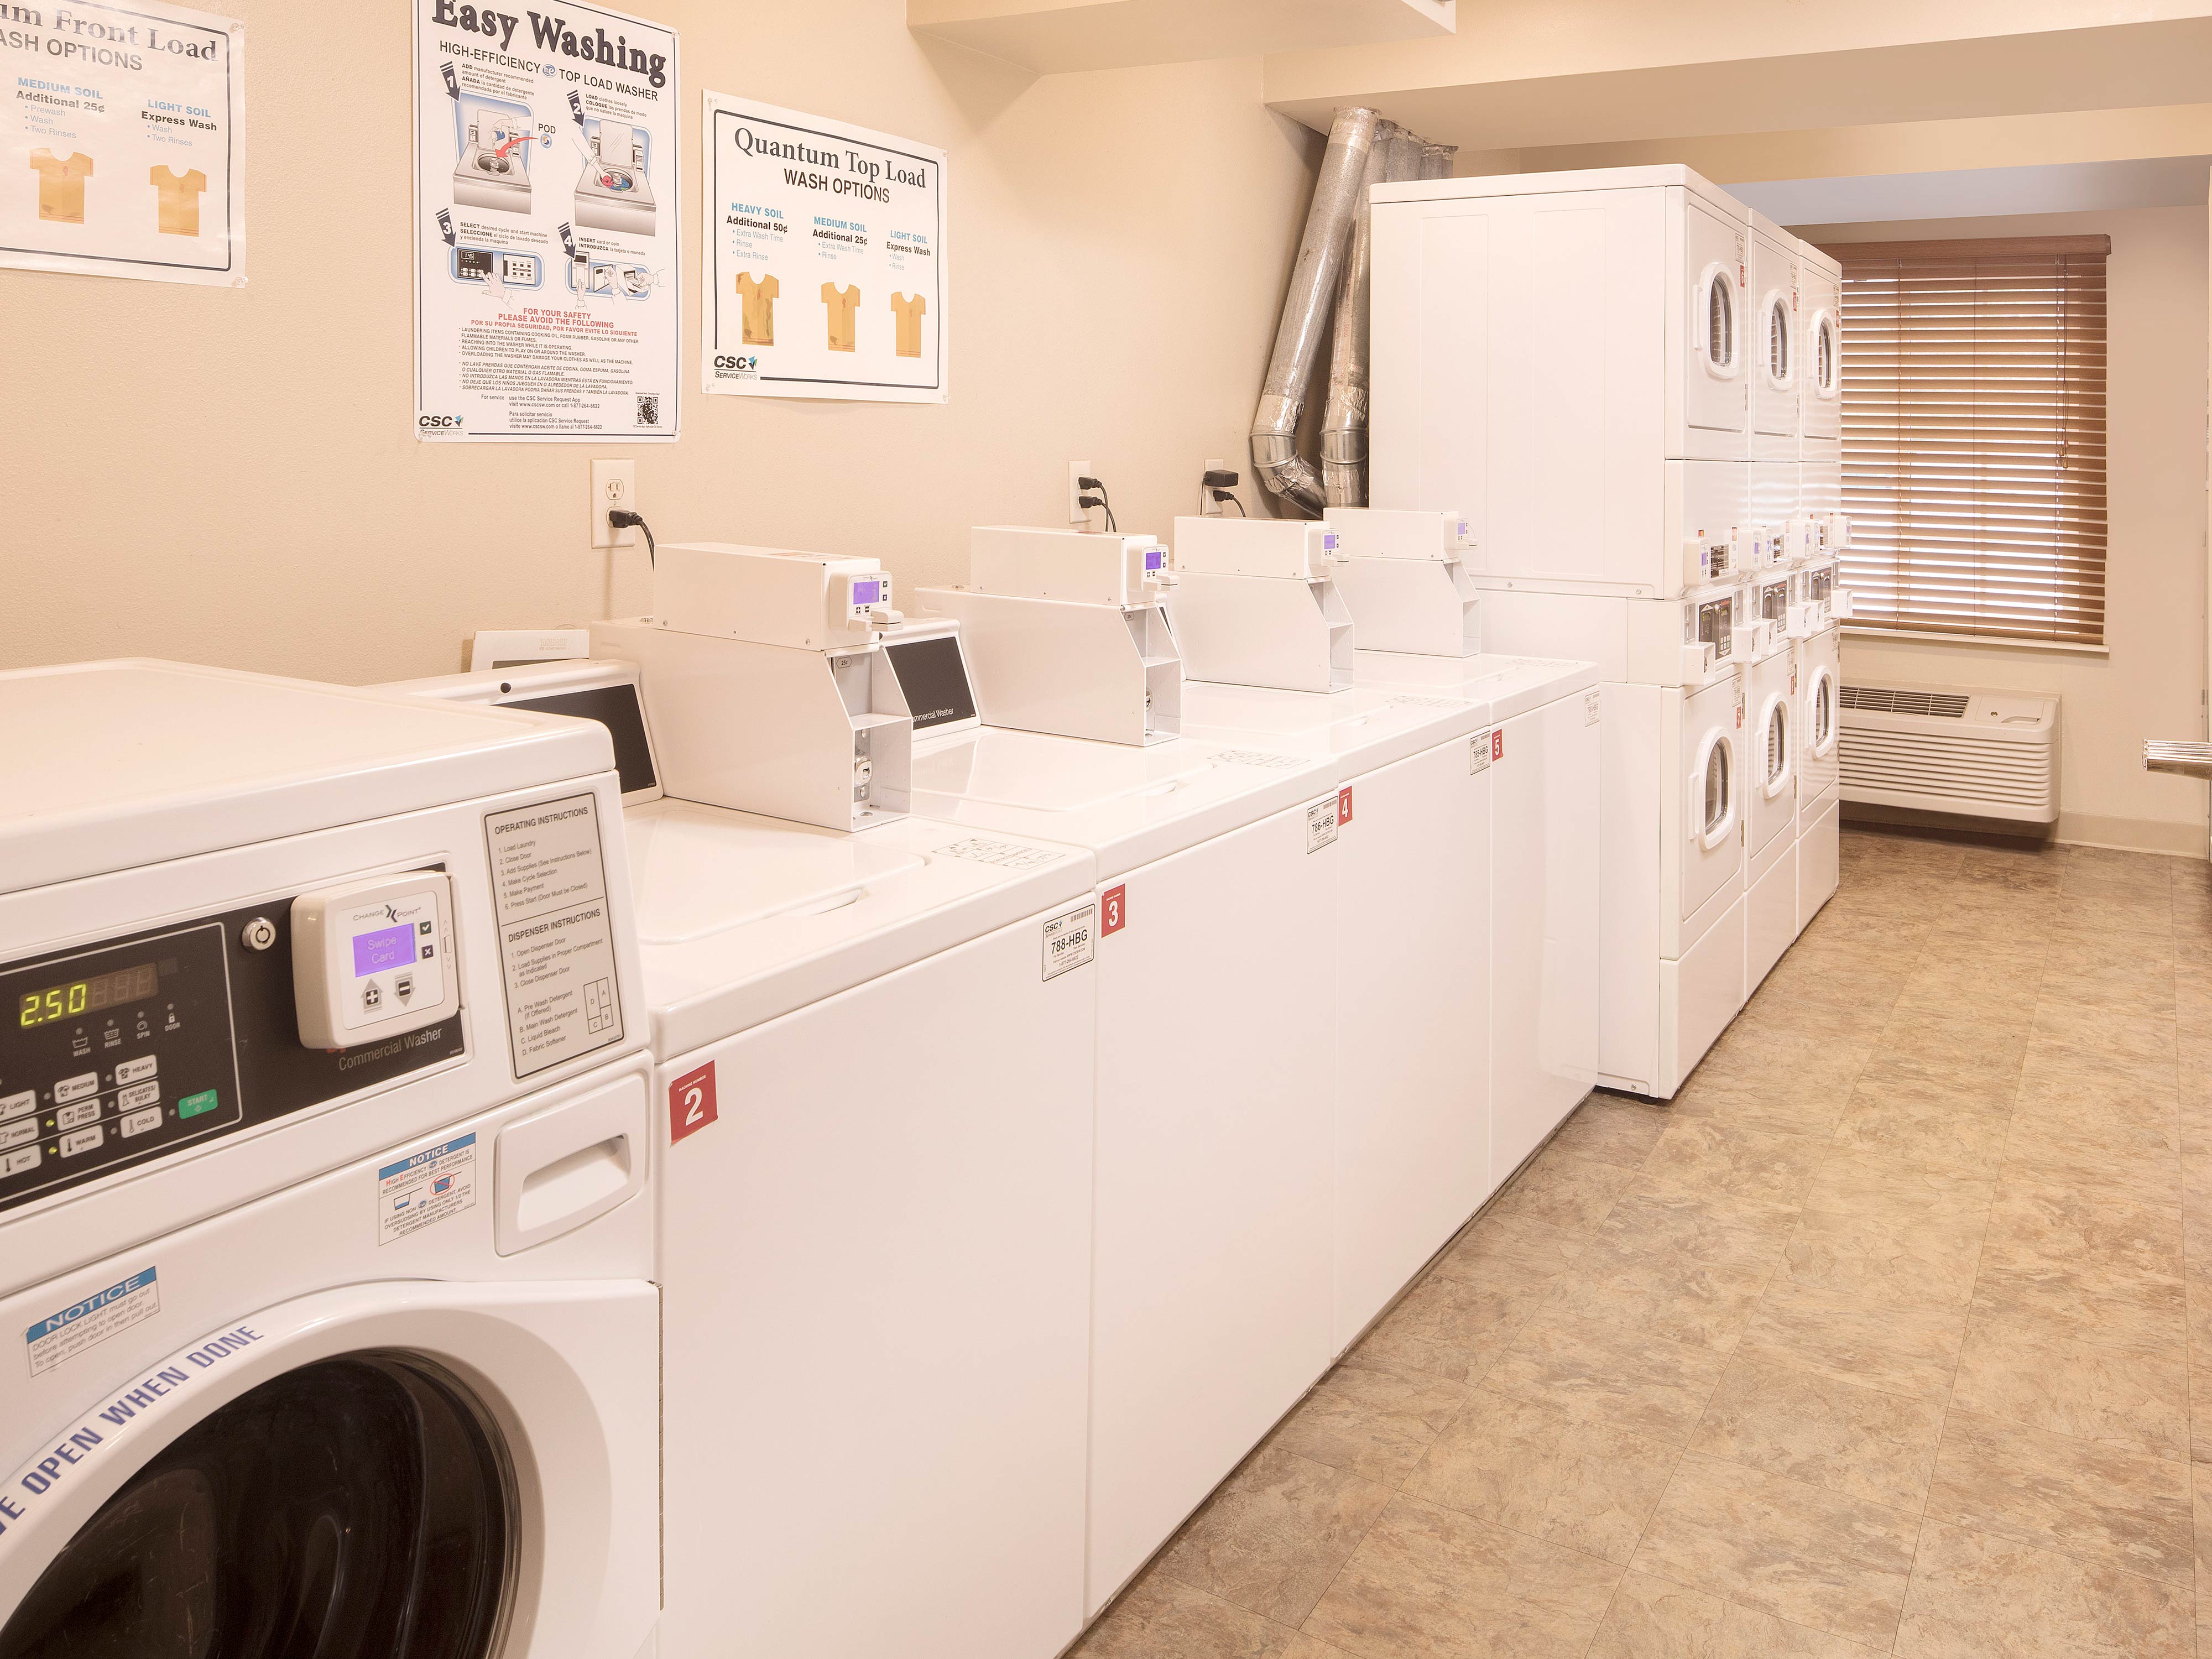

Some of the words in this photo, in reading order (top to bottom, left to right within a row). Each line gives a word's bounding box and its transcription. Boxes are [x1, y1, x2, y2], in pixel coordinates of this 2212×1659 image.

[54, 9, 139, 45] Front
[148, 28, 218, 61] Load
[432, 0, 518, 51] Easy
[527, 11, 666, 88] Washing
[47, 39, 142, 71] OPTIONS
[440, 40, 541, 73] HIGH-EFFICIENCY
[559, 69, 580, 82] TOP
[584, 75, 612, 90] LOAD
[615, 82, 658, 101] WASHER
[474, 67, 503, 76] manufacturer
[504, 74, 534, 83] recommended
[447, 75, 453, 88] 1
[18, 77, 70, 94] MEDIUM
[75, 87, 103, 100] SOIL
[16, 91, 79, 108] Additional
[84, 102, 105, 113] 25¢
[573, 103, 581, 114] 2
[30, 105, 66, 116] Prewash
[148, 100, 182, 112] LIGHT
[186, 106, 211, 118] SOIL
[30, 115, 53, 124] Wash
[142, 111, 185, 126] Express
[189, 119, 217, 131] Wash
[30, 125, 46, 134] Two
[49, 128, 76, 138] Rinses
[152, 124, 172, 133] Wash
[539, 123, 556, 134] POD
[168, 137, 192, 146] Rinses
[734, 128, 840, 169] Quantum
[846, 150, 880, 184] Top
[885, 159, 926, 188] Load
[784, 168, 828, 192] WASH
[833, 178, 890, 204] OPTIONS
[732, 202, 761, 215] HEAVY
[765, 208, 784, 219] SOIL
[443, 222, 451, 234] 3
[727, 215, 770, 229] Additional
[774, 223, 787, 233] 50¢
[814, 216, 847, 229] MEDIUM
[850, 222, 867, 232] SOIL
[737, 229, 751, 237] Extra
[753, 231, 768, 239] Wash
[812, 229, 852, 242] Additional
[855, 236, 867, 246] 25¢
[890, 230, 910, 240] LIGHT
[912, 234, 927, 244] SOIL
[564, 236, 572, 247] 4
[737, 239, 752, 248] Rinse
[886, 242, 911, 253] Express
[914, 247, 930, 256] Wash
[753, 252, 768, 260] Rinse
[572, 319, 614, 328] FOLLOWING
[714, 355, 747, 368] CSC
[419, 416, 452, 427] CSC
[912, 711, 936, 722] ommercial
[936, 708, 953, 717] Washer
[1495, 739, 1499, 755] 5
[1342, 798, 1348, 817] 4
[495, 818, 536, 834] OPERATING
[538, 807, 588, 825] INSTRUCTIONS
[1312, 815, 1333, 833] 786-HBG
[353, 910, 384, 921] CHANGE
[1109, 901, 1118, 927] 3
[508, 925, 549, 943] DISPENSER
[551, 909, 601, 930] INSTRUCTIONS
[1045, 922, 1058, 933] CSC
[367, 936, 397, 951] Swipe
[1051, 929, 1087, 954] 788-HBG
[371, 951, 394, 964] Card
[20, 983, 87, 1026] 2.50
[165, 1022, 180, 1031] DOOR
[105, 1039, 122, 1048] RINSE
[339, 1041, 401, 1071] Commercial
[405, 1028, 442, 1048] Washer
[73, 1047, 90, 1057] WASH
[132, 1063, 153, 1073] HEAVY
[72, 1080, 95, 1091] MEDIUM
[10, 1098, 30, 1110] LIGHT
[134, 1093, 150, 1103] BULKY
[187, 1095, 207, 1105] START
[78, 1104, 93, 1113] PERM
[685, 1087, 703, 1126] 2
[77, 1110, 95, 1120] PRESS
[137, 1117, 154, 1126] COLD
[11, 1126, 34, 1138] NORMAL
[75, 1135, 96, 1145] WARM
[17, 1156, 30, 1165] HOT
[409, 1145, 448, 1167] NOTICE
[383, 1177, 418, 1195] RECOMMENDED
[429, 1168, 439, 1177] BEST
[441, 1155, 472, 1171] PERFORMANCE
[46, 1276, 140, 1332] NOTICE
[22, 1426, 105, 1495] OPEN
[98, 1366, 190, 1426] WHEN
[186, 1326, 264, 1368] DONE
